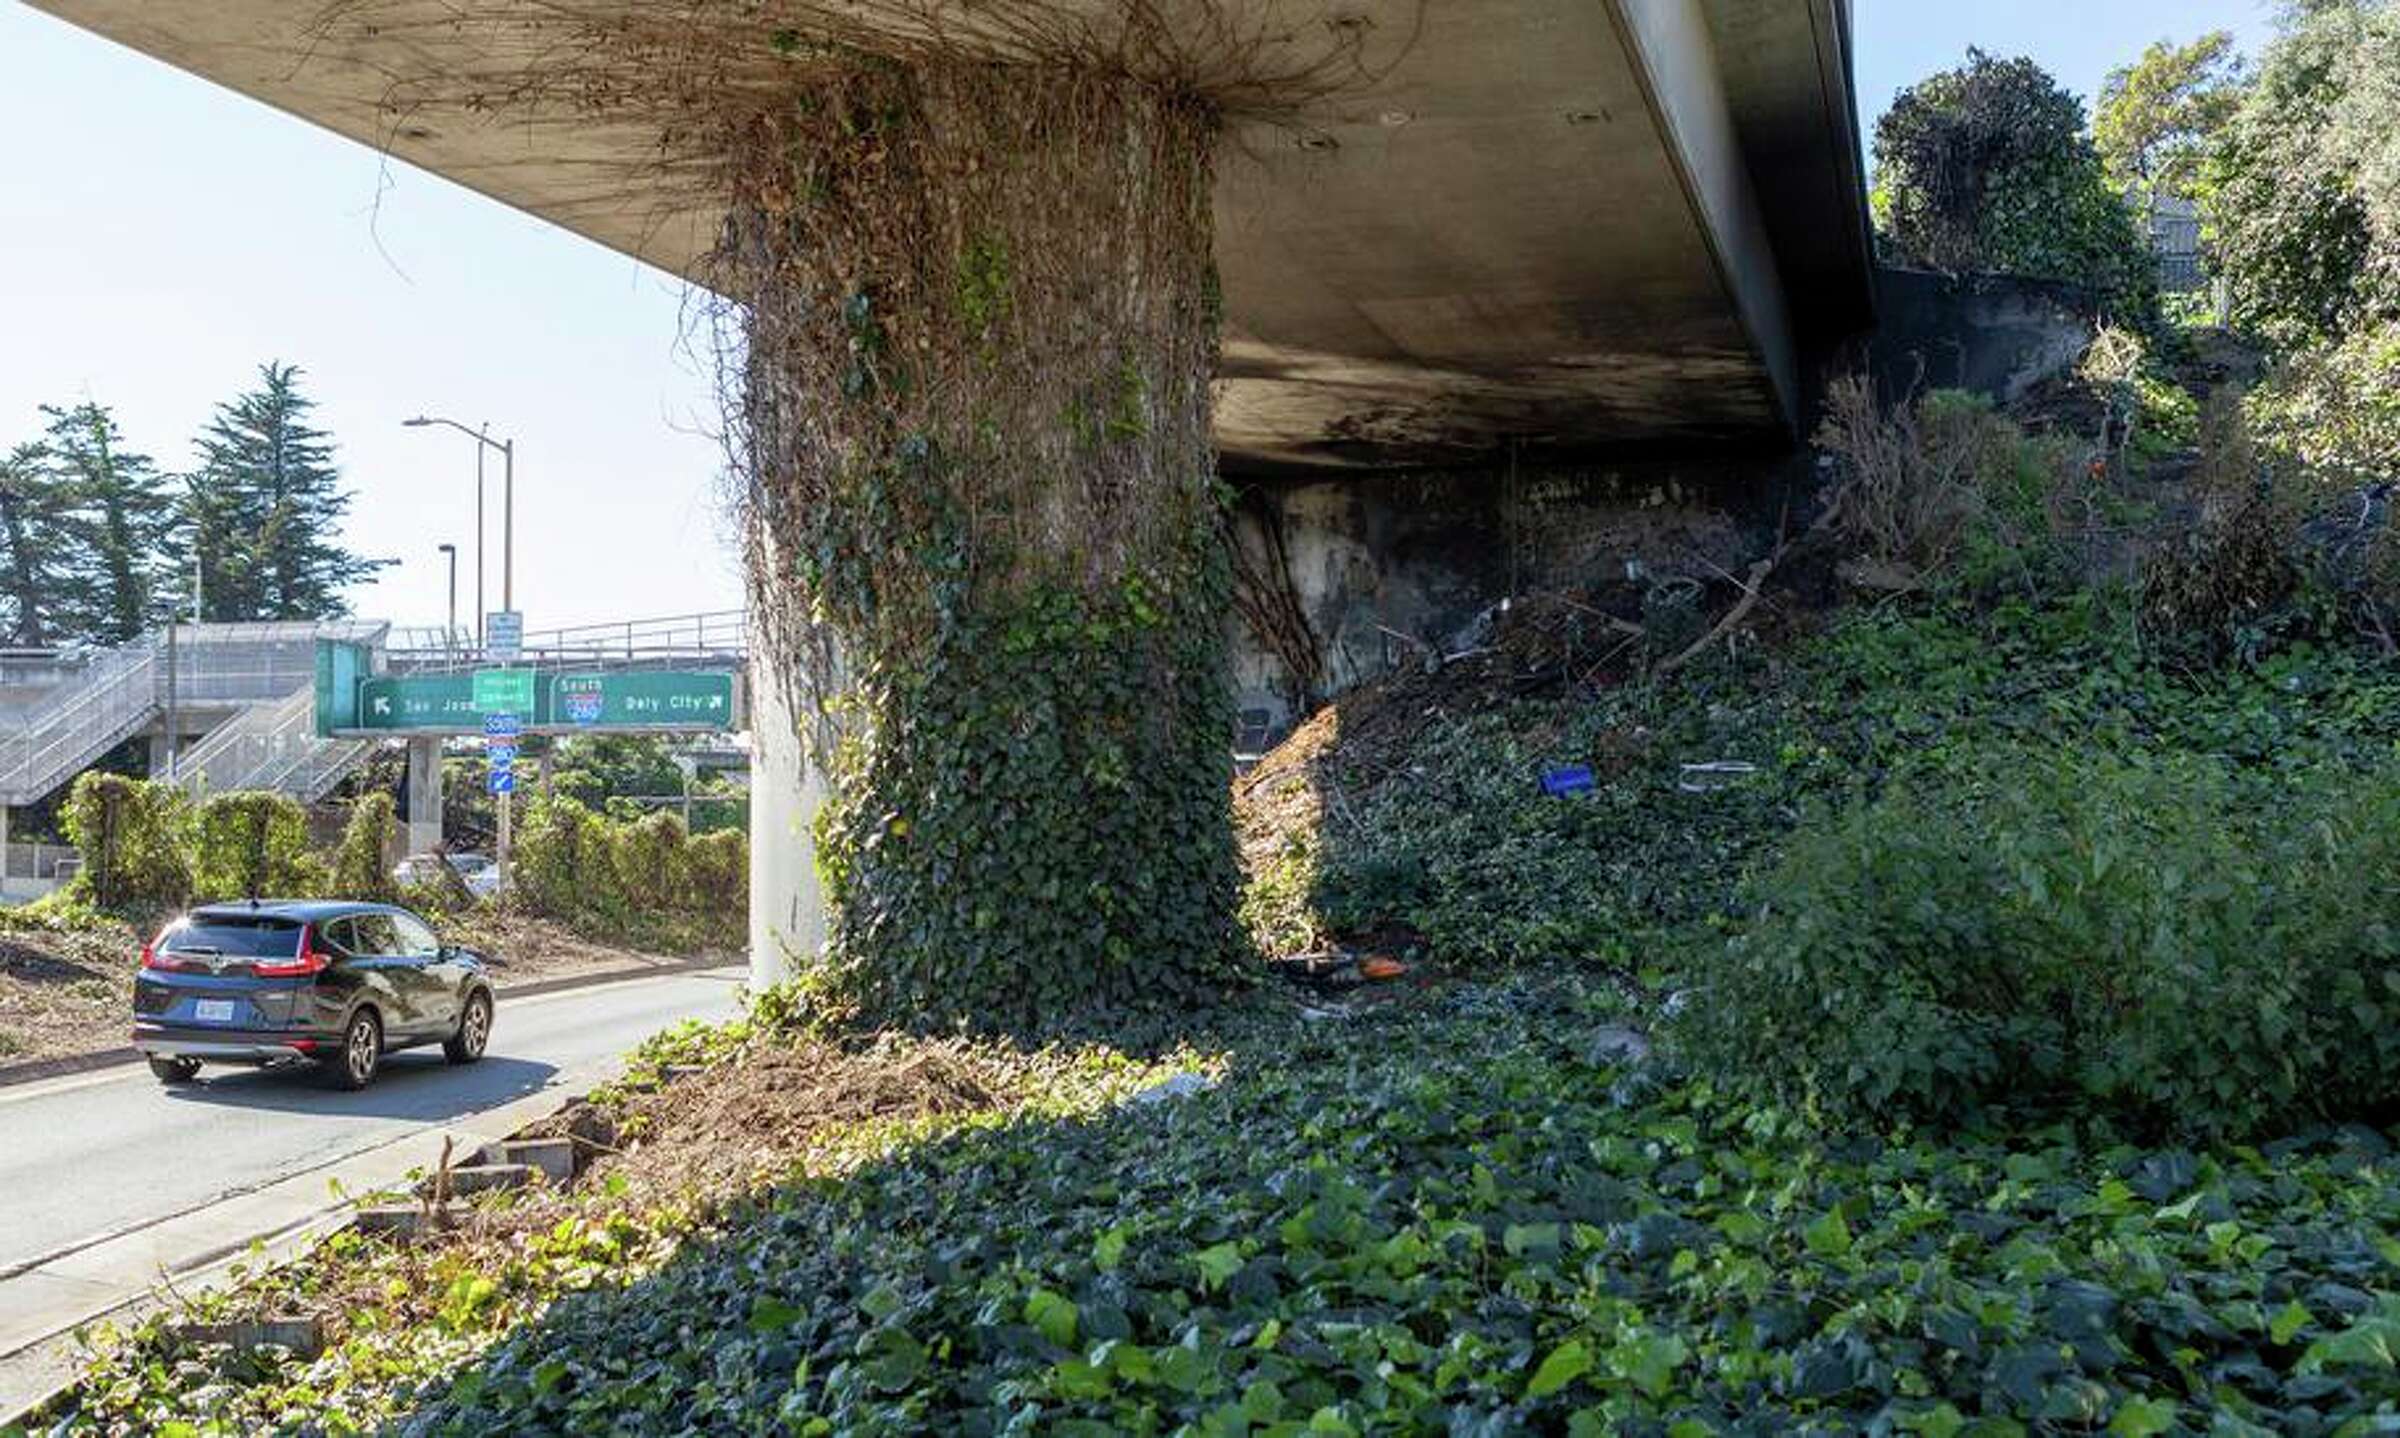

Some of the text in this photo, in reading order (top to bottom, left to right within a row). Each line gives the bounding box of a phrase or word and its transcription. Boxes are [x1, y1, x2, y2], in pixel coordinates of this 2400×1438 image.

[560, 679, 602, 692] South
[625, 695, 702, 710] Daly City
